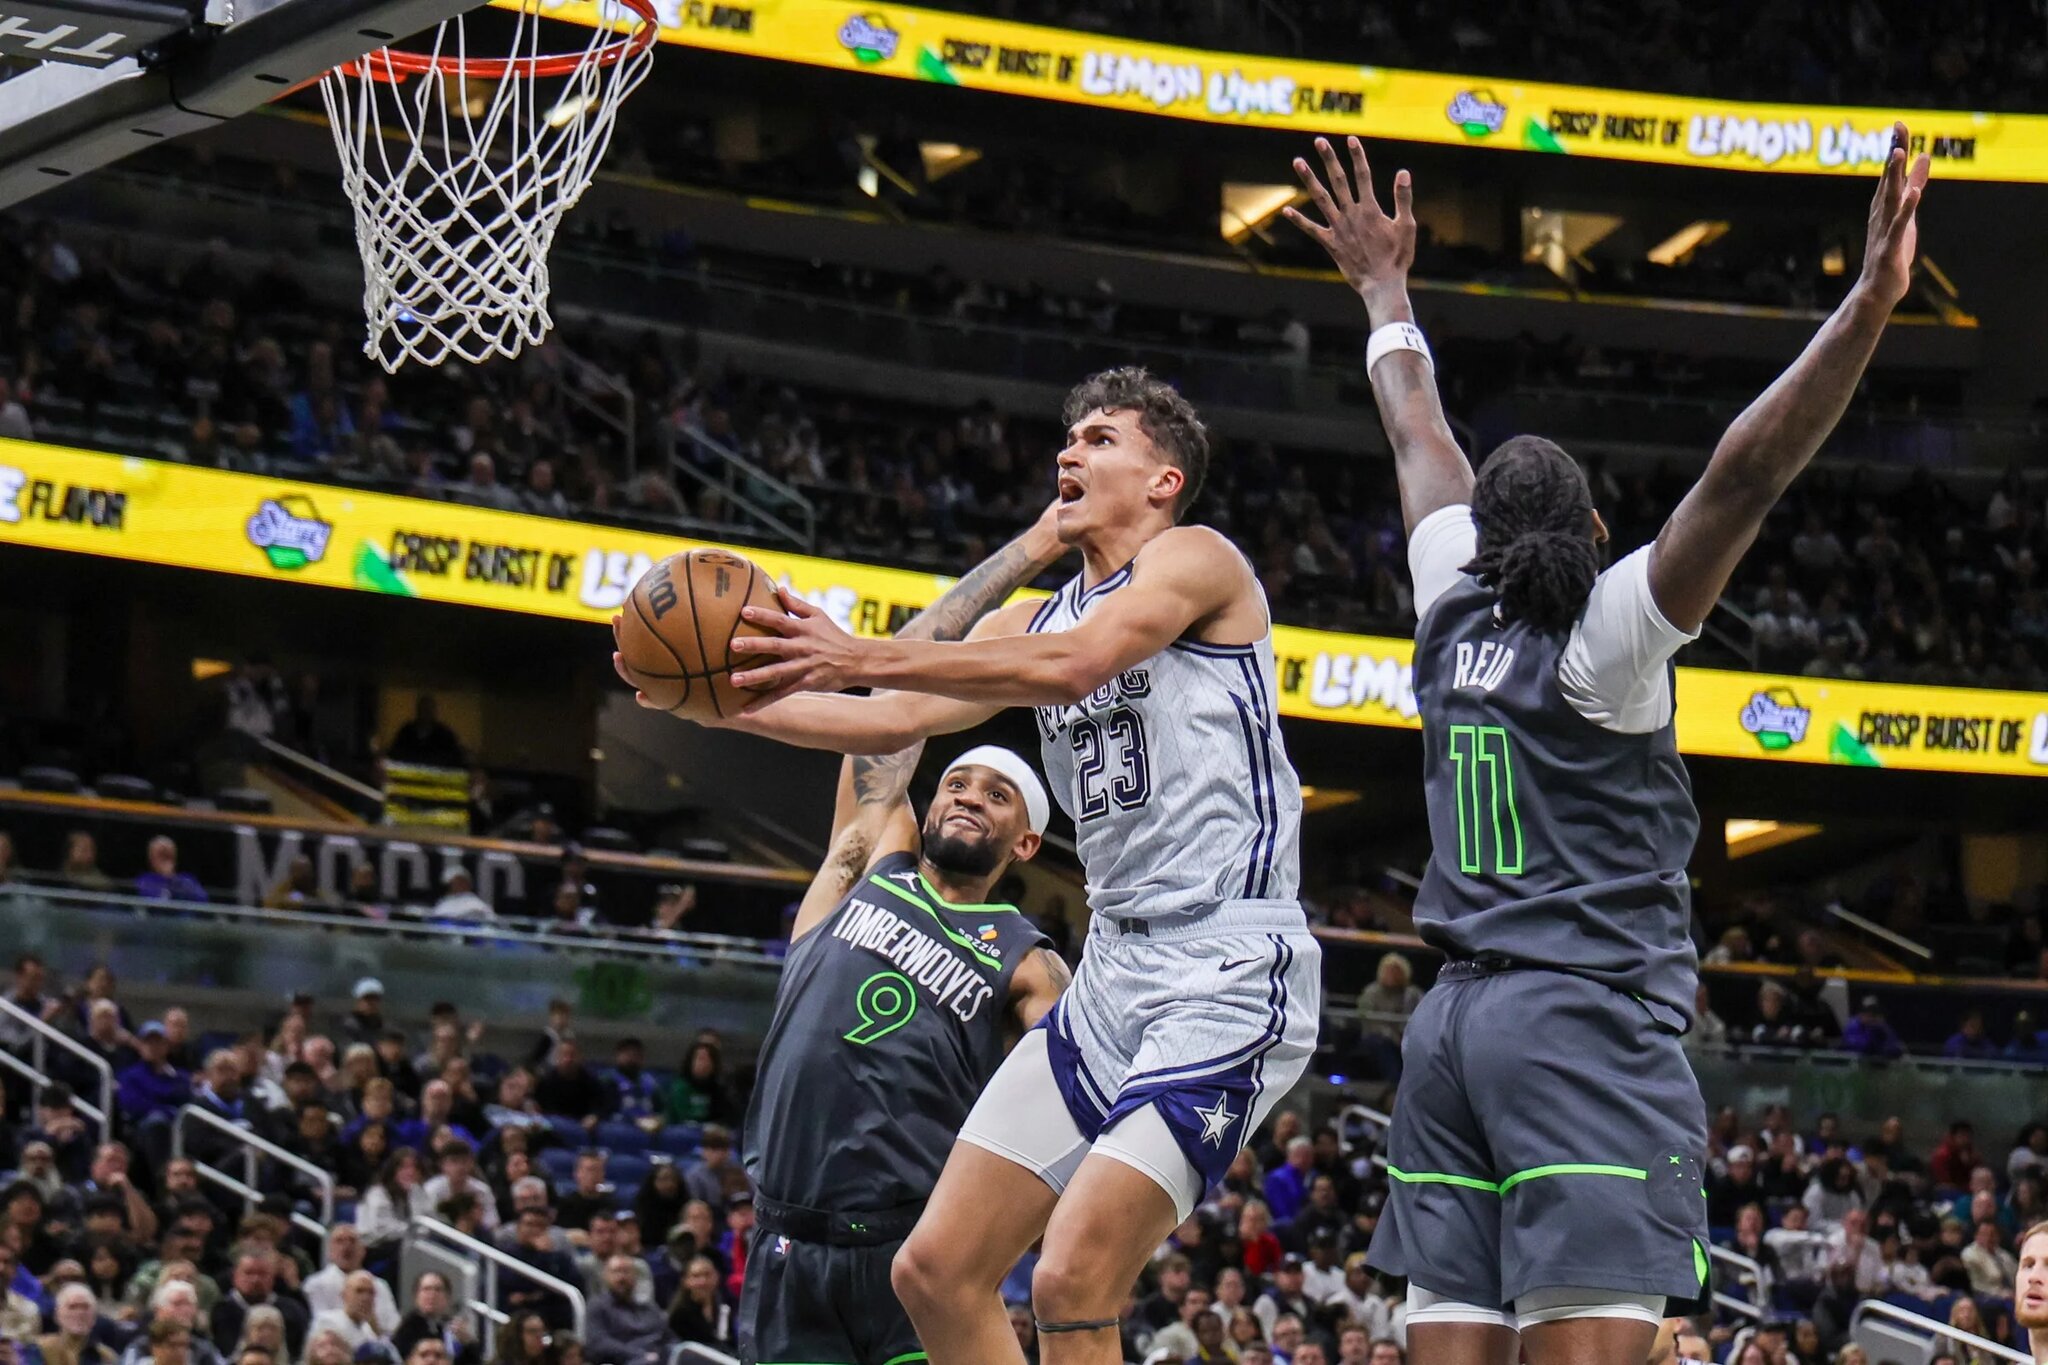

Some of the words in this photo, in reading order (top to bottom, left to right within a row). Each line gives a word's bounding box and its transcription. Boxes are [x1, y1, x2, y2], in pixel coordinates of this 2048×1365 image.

[1081, 50, 1202, 106] LEMON
[1207, 69, 1296, 115] LIME
[1688, 115, 1812, 163] LEMON
[1819, 120, 1894, 166] LIM
[391, 530, 459, 575] CRISP
[465, 541, 541, 591] BURST
[548, 552, 574, 593] OF
[1283, 656, 1306, 693] OF
[1453, 641, 1514, 692] REID
[1069, 704, 1152, 823] 23
[1859, 711, 1921, 749] CRISP
[1926, 714, 1992, 753] BURST
[1998, 719, 2025, 754] OF
[1450, 725, 1523, 876] 11
[832, 898, 994, 1024] TIMBERWOLVES
[843, 971, 917, 1046] 9
